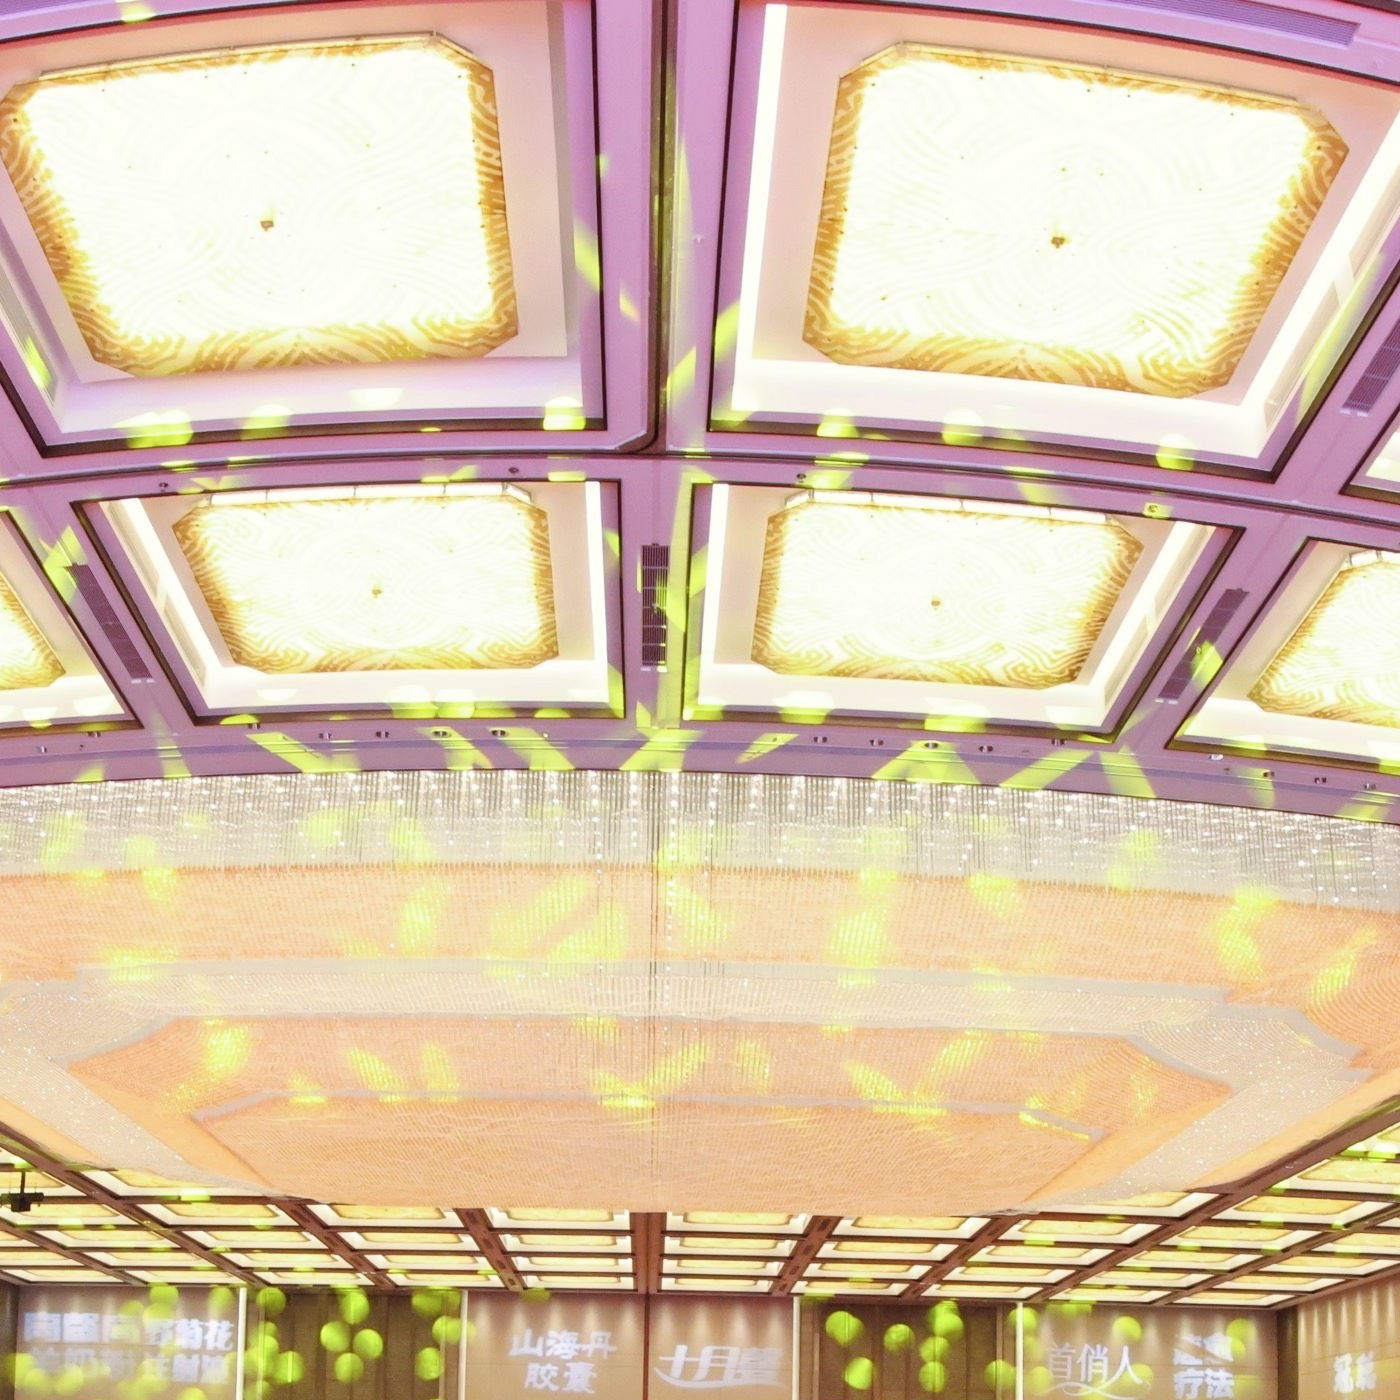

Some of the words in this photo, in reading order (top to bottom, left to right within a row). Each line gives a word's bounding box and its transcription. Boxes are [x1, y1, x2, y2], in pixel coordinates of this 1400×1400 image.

[509, 1328, 617, 1361] 山海丹
[524, 1362, 598, 1394] 胶囊
